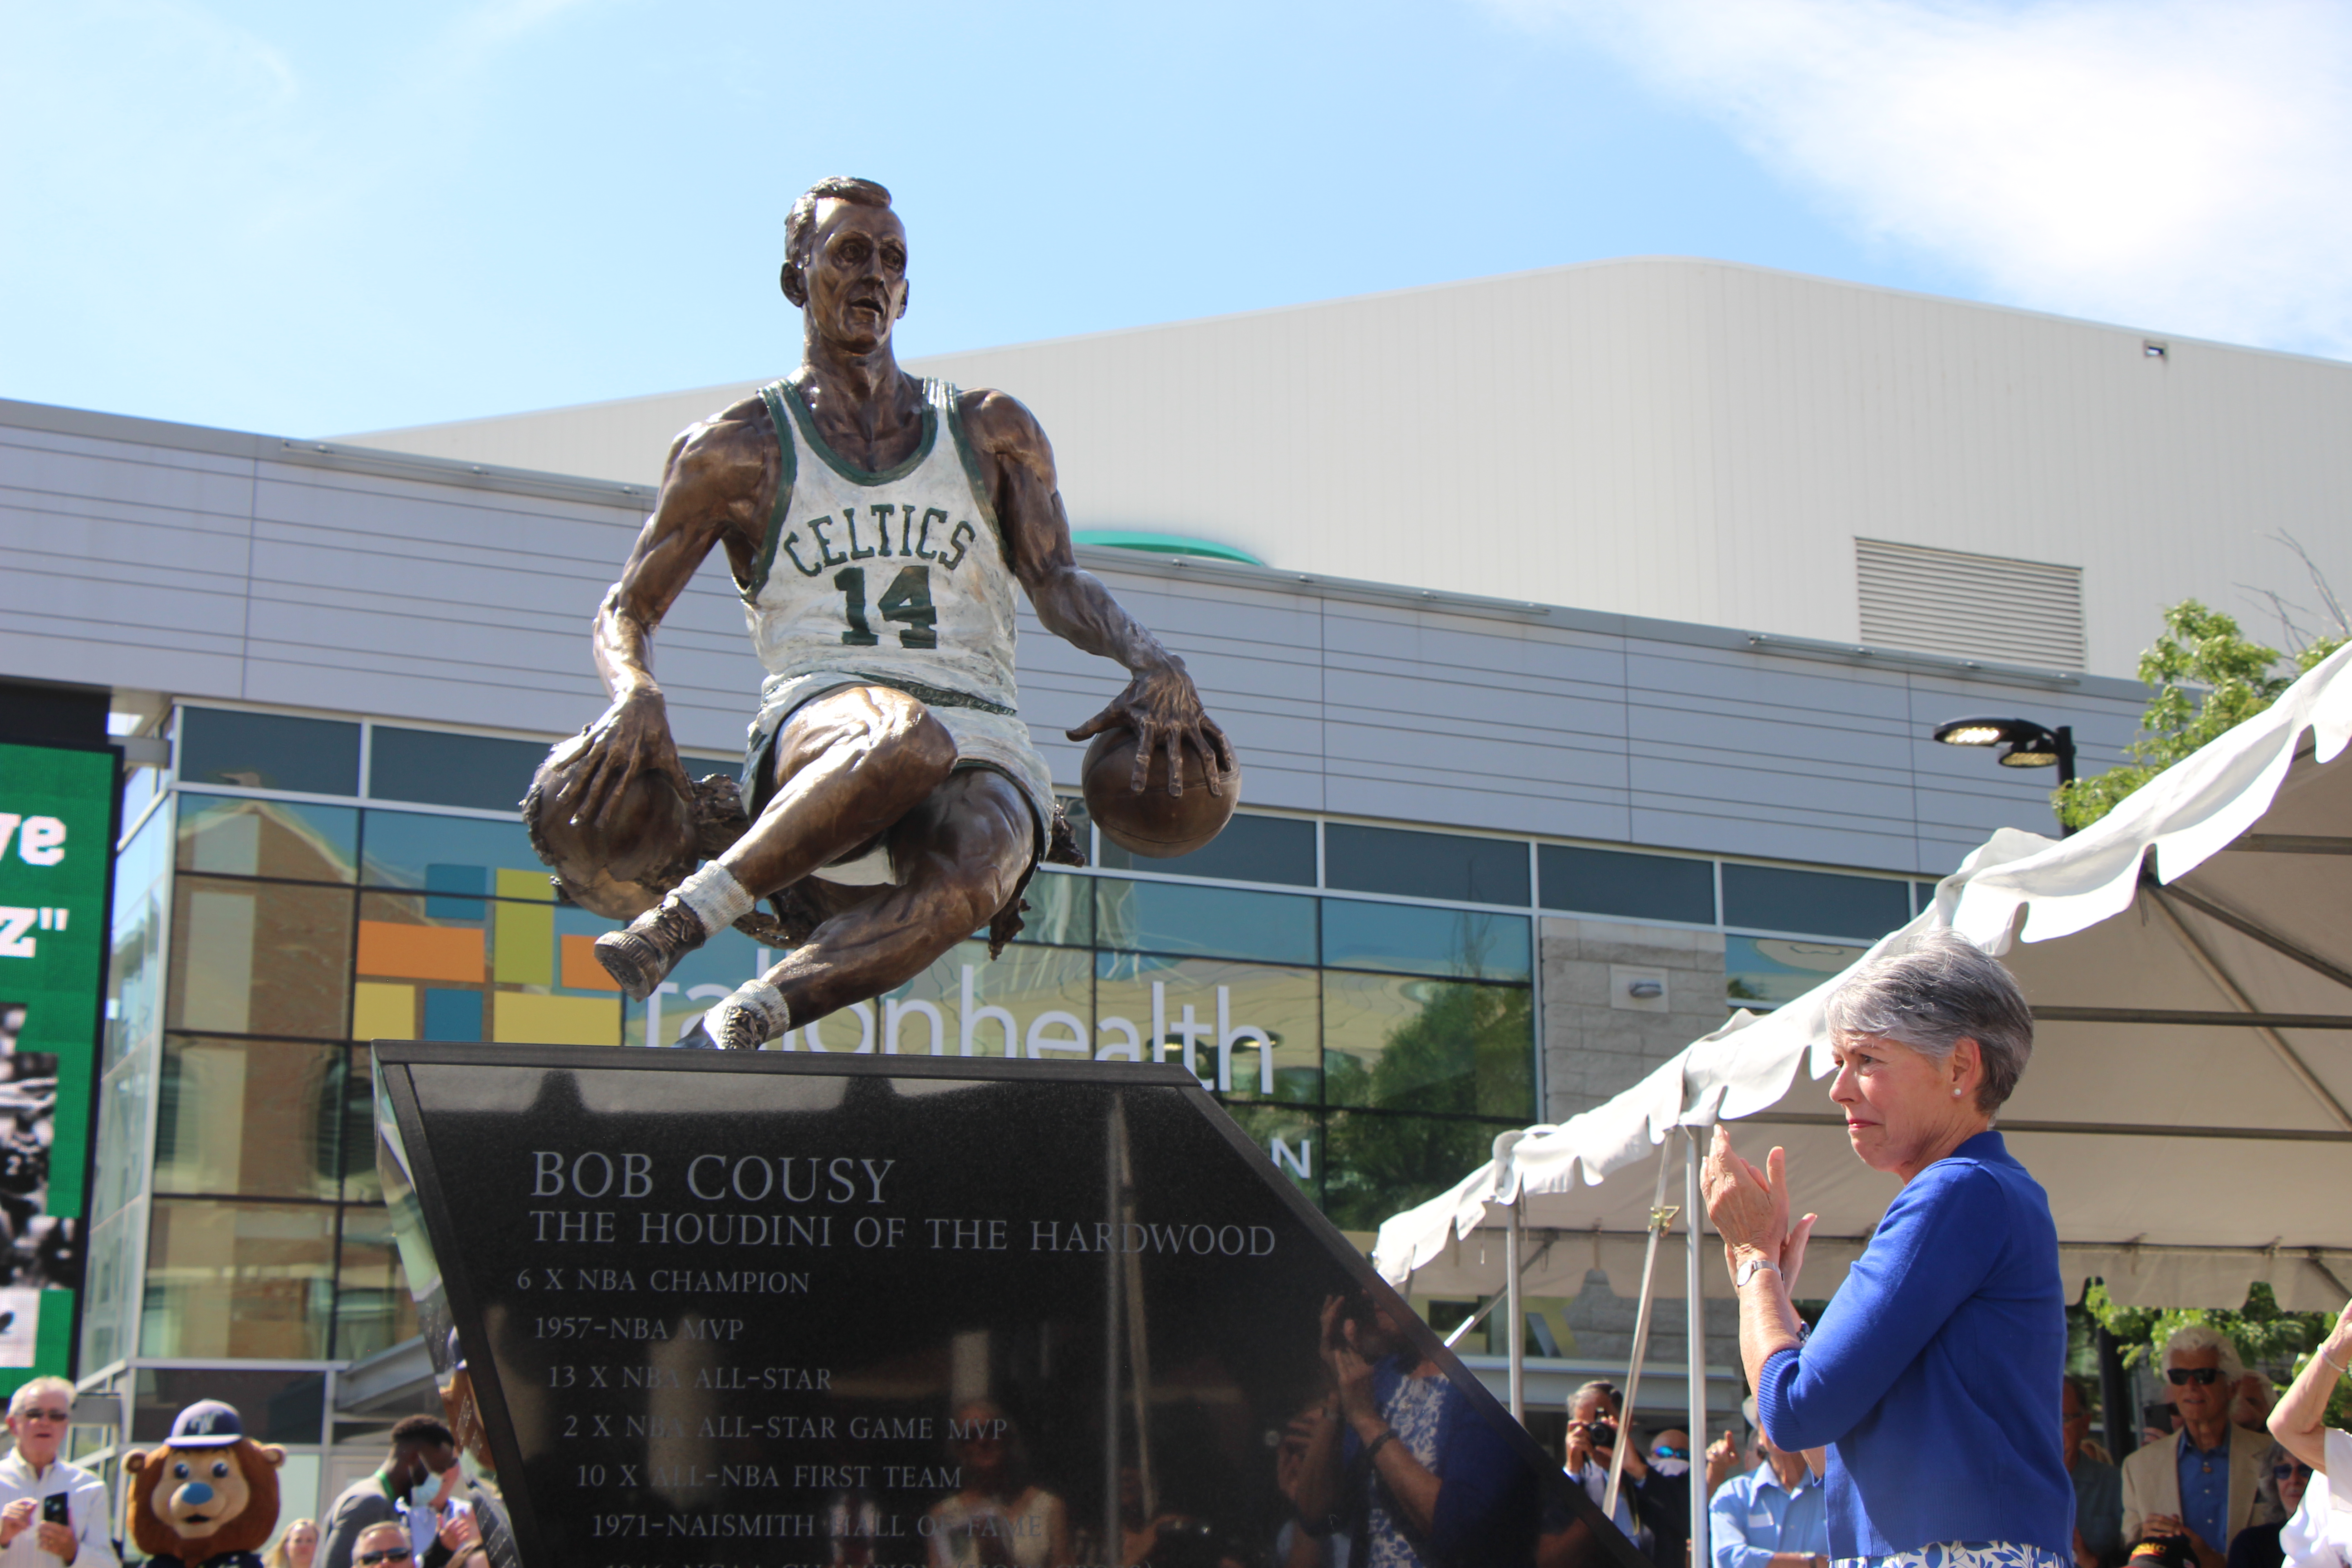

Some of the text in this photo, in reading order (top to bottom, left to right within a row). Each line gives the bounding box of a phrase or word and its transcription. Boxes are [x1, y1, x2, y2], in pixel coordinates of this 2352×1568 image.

[784, 504, 975, 577] CELTICS
[834, 565, 937, 649] 14
[530, 1151, 896, 1204] BOB COUSY
[529, 1210, 1276, 1256] THE HOUDINI OF THE HARDWOOD
[516, 1268, 810, 1294] 6 X NBA CHAMPION
[535, 1316, 745, 1342] 1957-NBA MVP
[549, 1365, 833, 1391] 13 X NBA ALL-STAR
[563, 1414, 1009, 1441] 2 X NBA ALL-STAR GAME MVP
[577, 1464, 962, 1489] 10 X ALL-NBA FIRST TEAM
[592, 1514, 1043, 1539] 1971-NAISMITH HALL OF FAME
